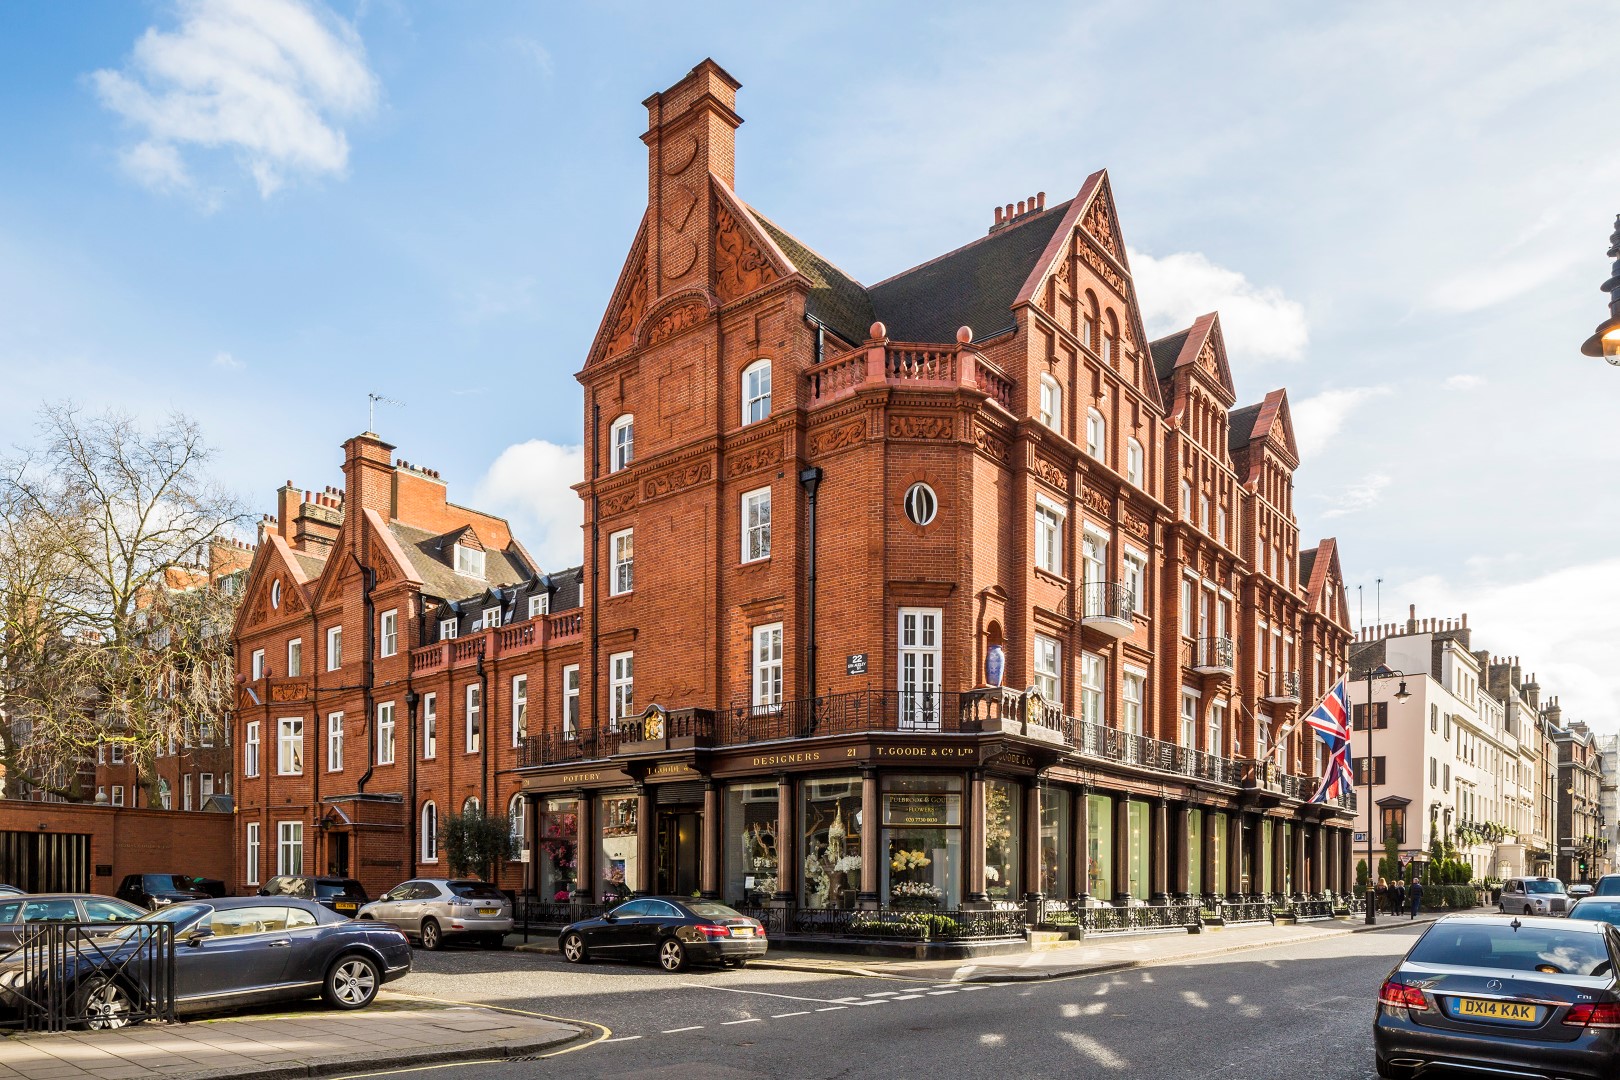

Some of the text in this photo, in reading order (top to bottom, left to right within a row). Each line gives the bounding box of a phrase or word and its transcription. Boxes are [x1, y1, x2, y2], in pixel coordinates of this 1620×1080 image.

[852, 654, 862, 664] 22
[753, 748, 856, 766] DESIGNERS 21
[931, 748, 937, 756] &
[563, 773, 601, 783] POTTERY
[1465, 1000, 1531, 1018] DX14 KAK
